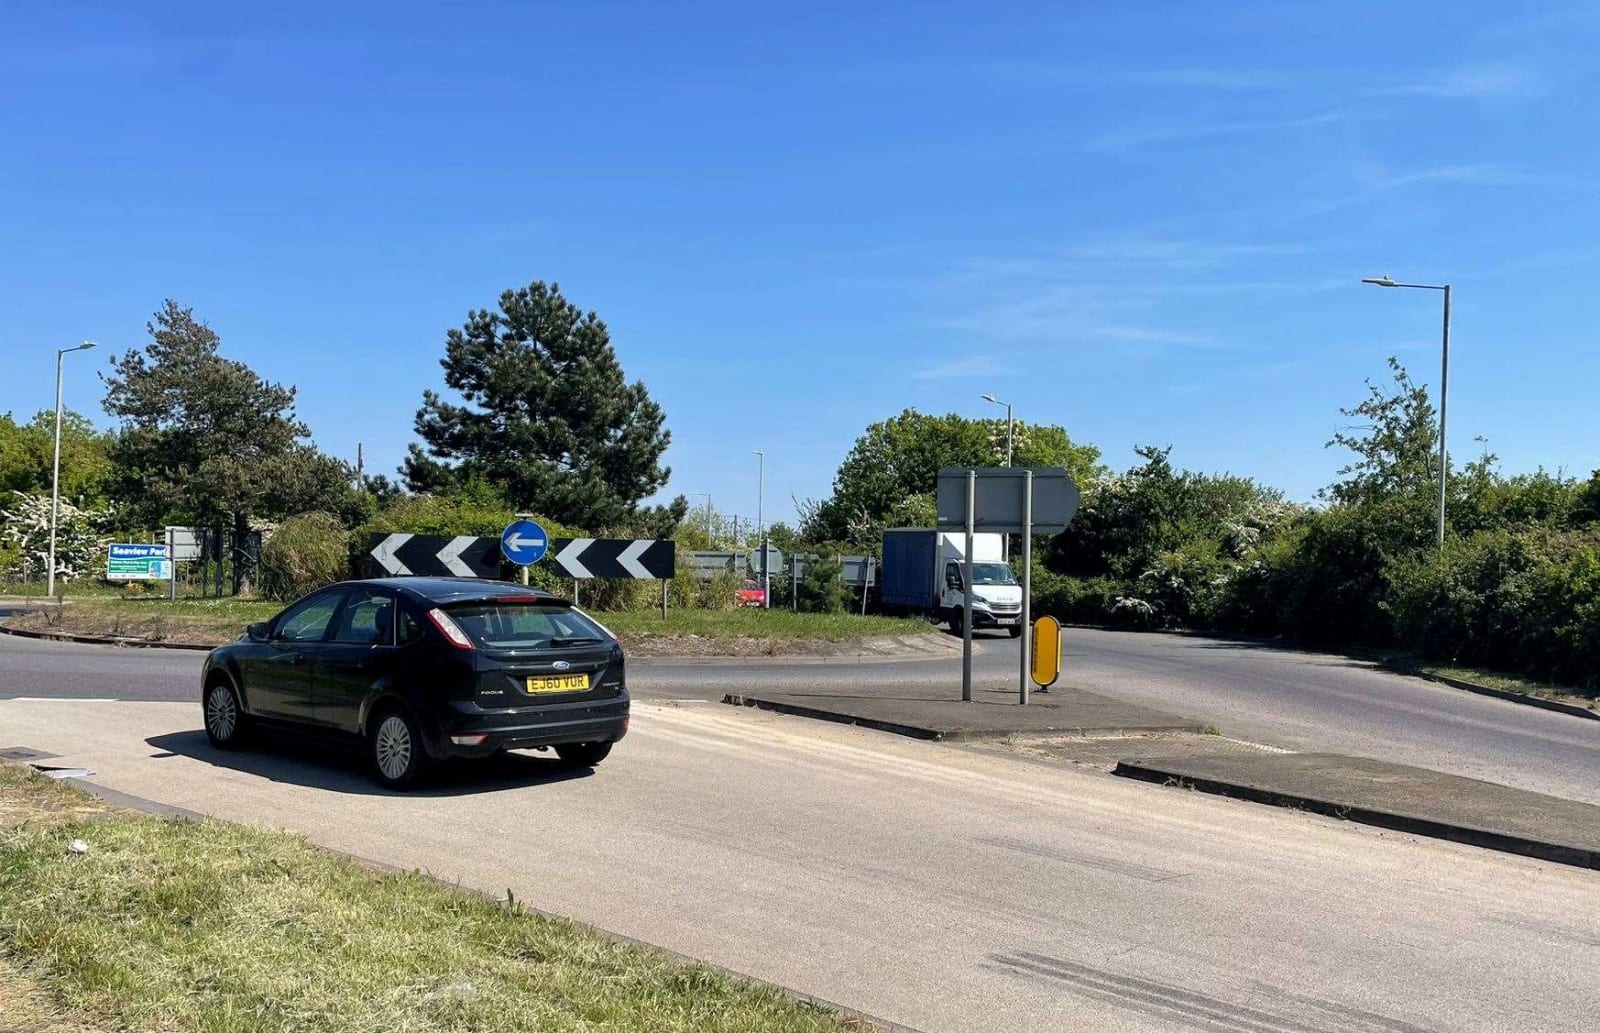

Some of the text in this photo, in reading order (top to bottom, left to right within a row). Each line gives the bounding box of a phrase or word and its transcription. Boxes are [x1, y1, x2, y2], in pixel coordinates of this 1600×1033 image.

[112, 546, 149, 556] Seaview
[531, 675, 584, 690] EJ60 VUR
